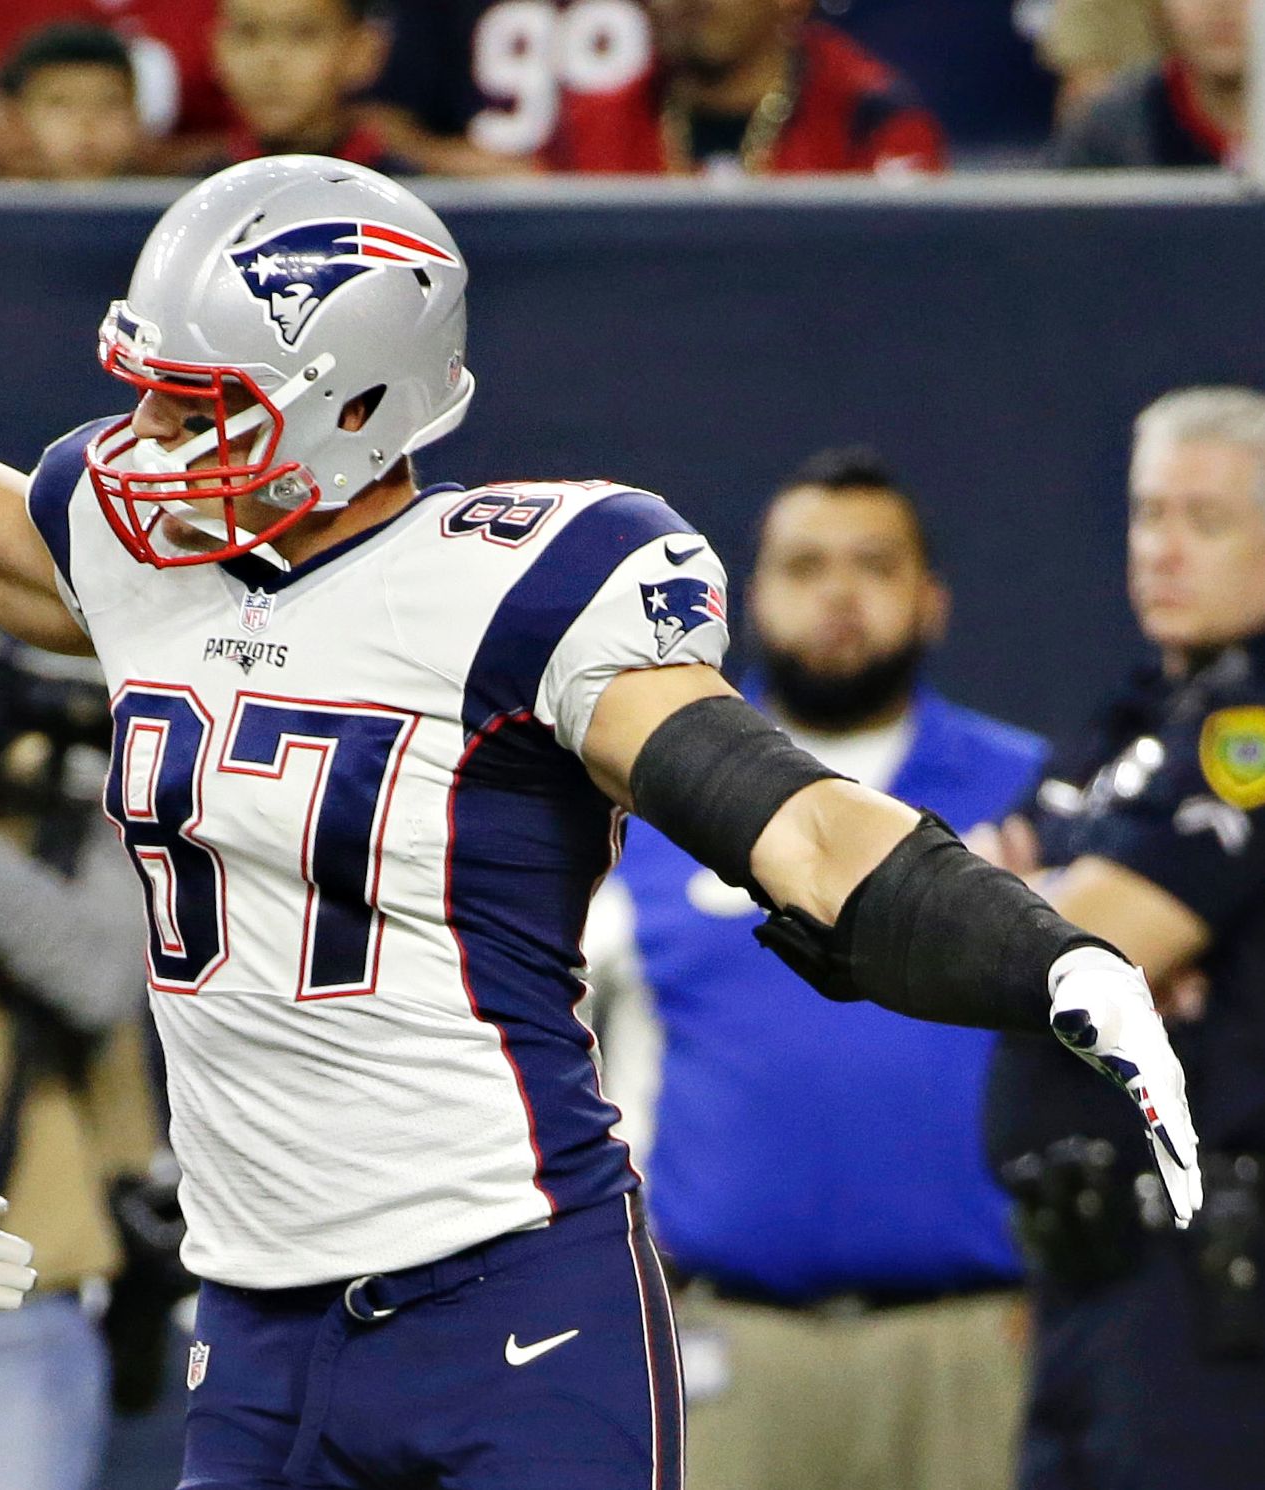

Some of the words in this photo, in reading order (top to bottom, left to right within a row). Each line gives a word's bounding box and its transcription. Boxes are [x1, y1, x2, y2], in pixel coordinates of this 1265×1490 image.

[441, 482, 565, 549] 8
[203, 637, 289, 668] PATRIOTS
[103, 679, 421, 1002] 87
